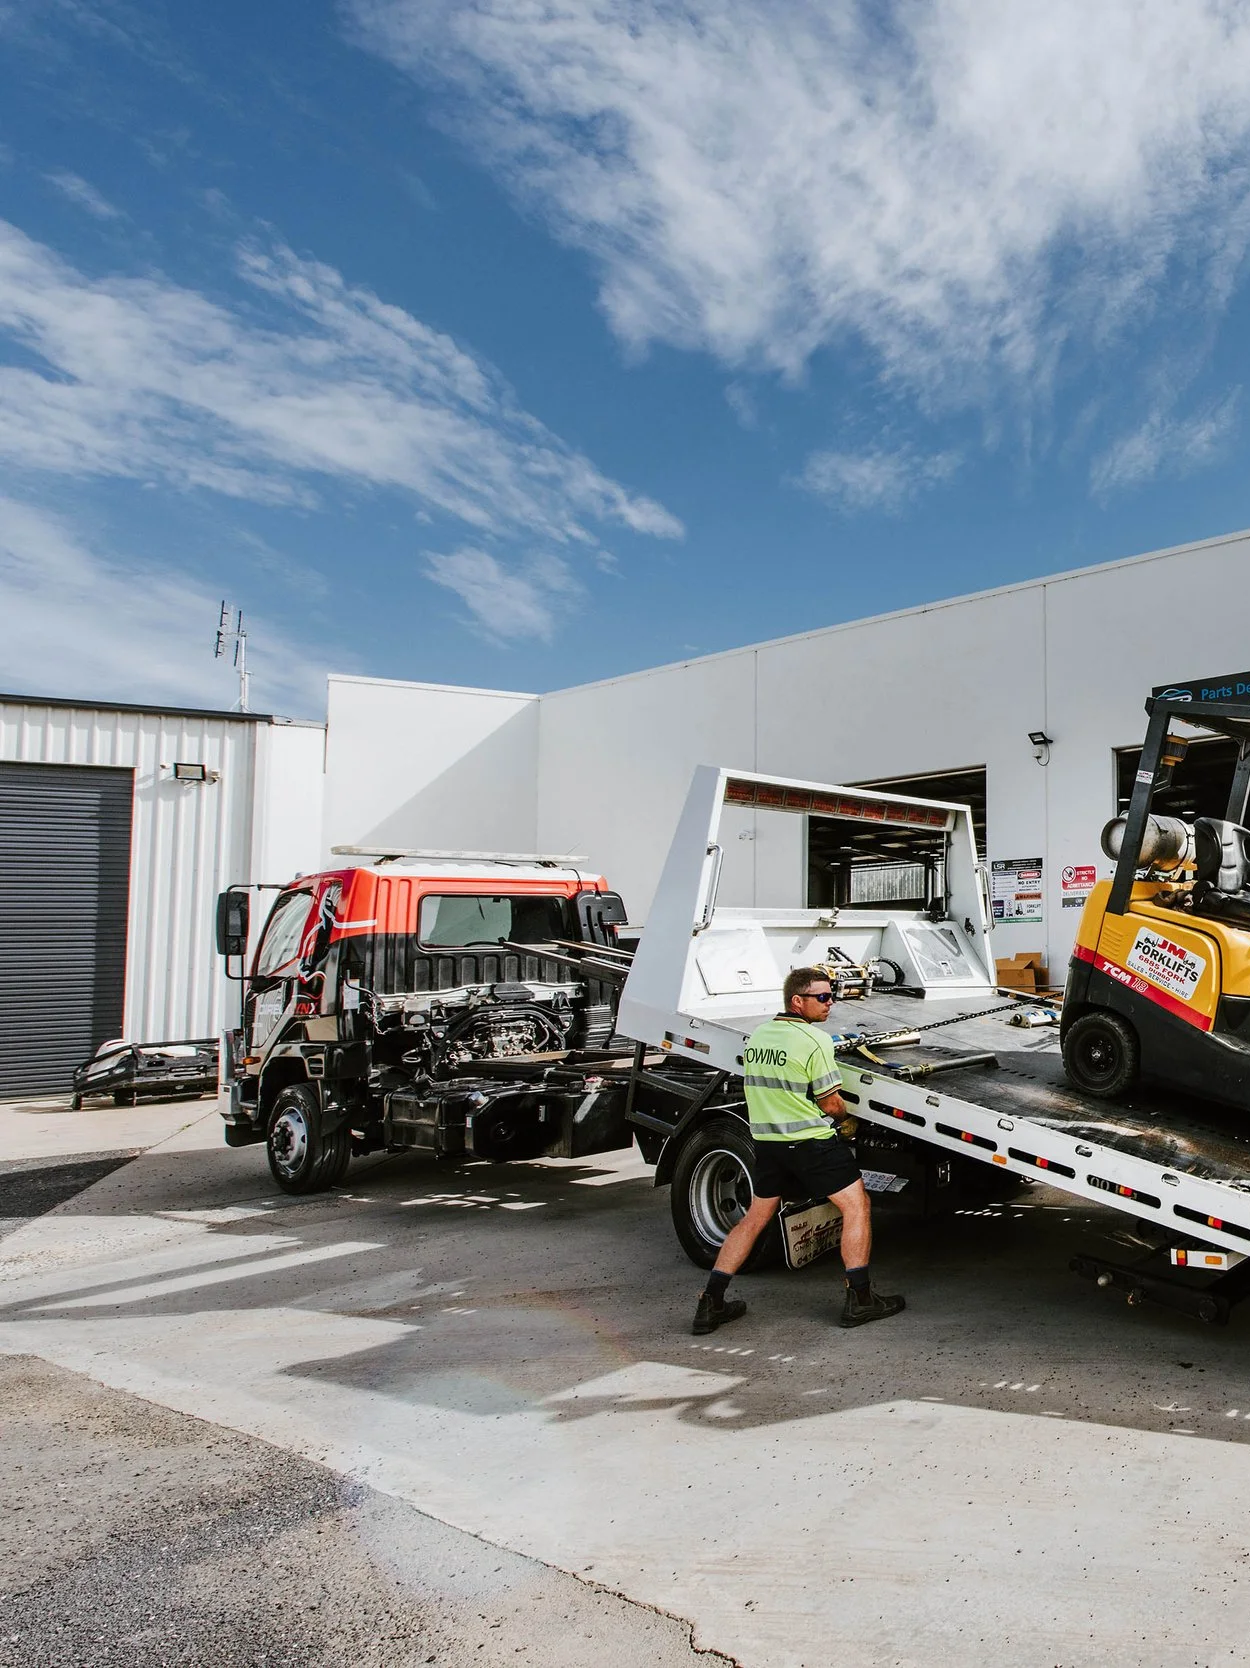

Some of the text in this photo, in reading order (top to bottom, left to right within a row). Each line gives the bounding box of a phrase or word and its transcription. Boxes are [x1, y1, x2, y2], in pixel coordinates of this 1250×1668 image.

[1201, 687, 1232, 700] Parts
[1134, 941, 1199, 982] FORKLIFTS
[1157, 939, 1187, 961] JM
[1102, 961, 1149, 993] TCM 18
[1127, 960, 1189, 999] SALES SERVICE HIRE
[1138, 954, 1186, 985] 6885 FORK
[1148, 966, 1171, 982] DUBBO
